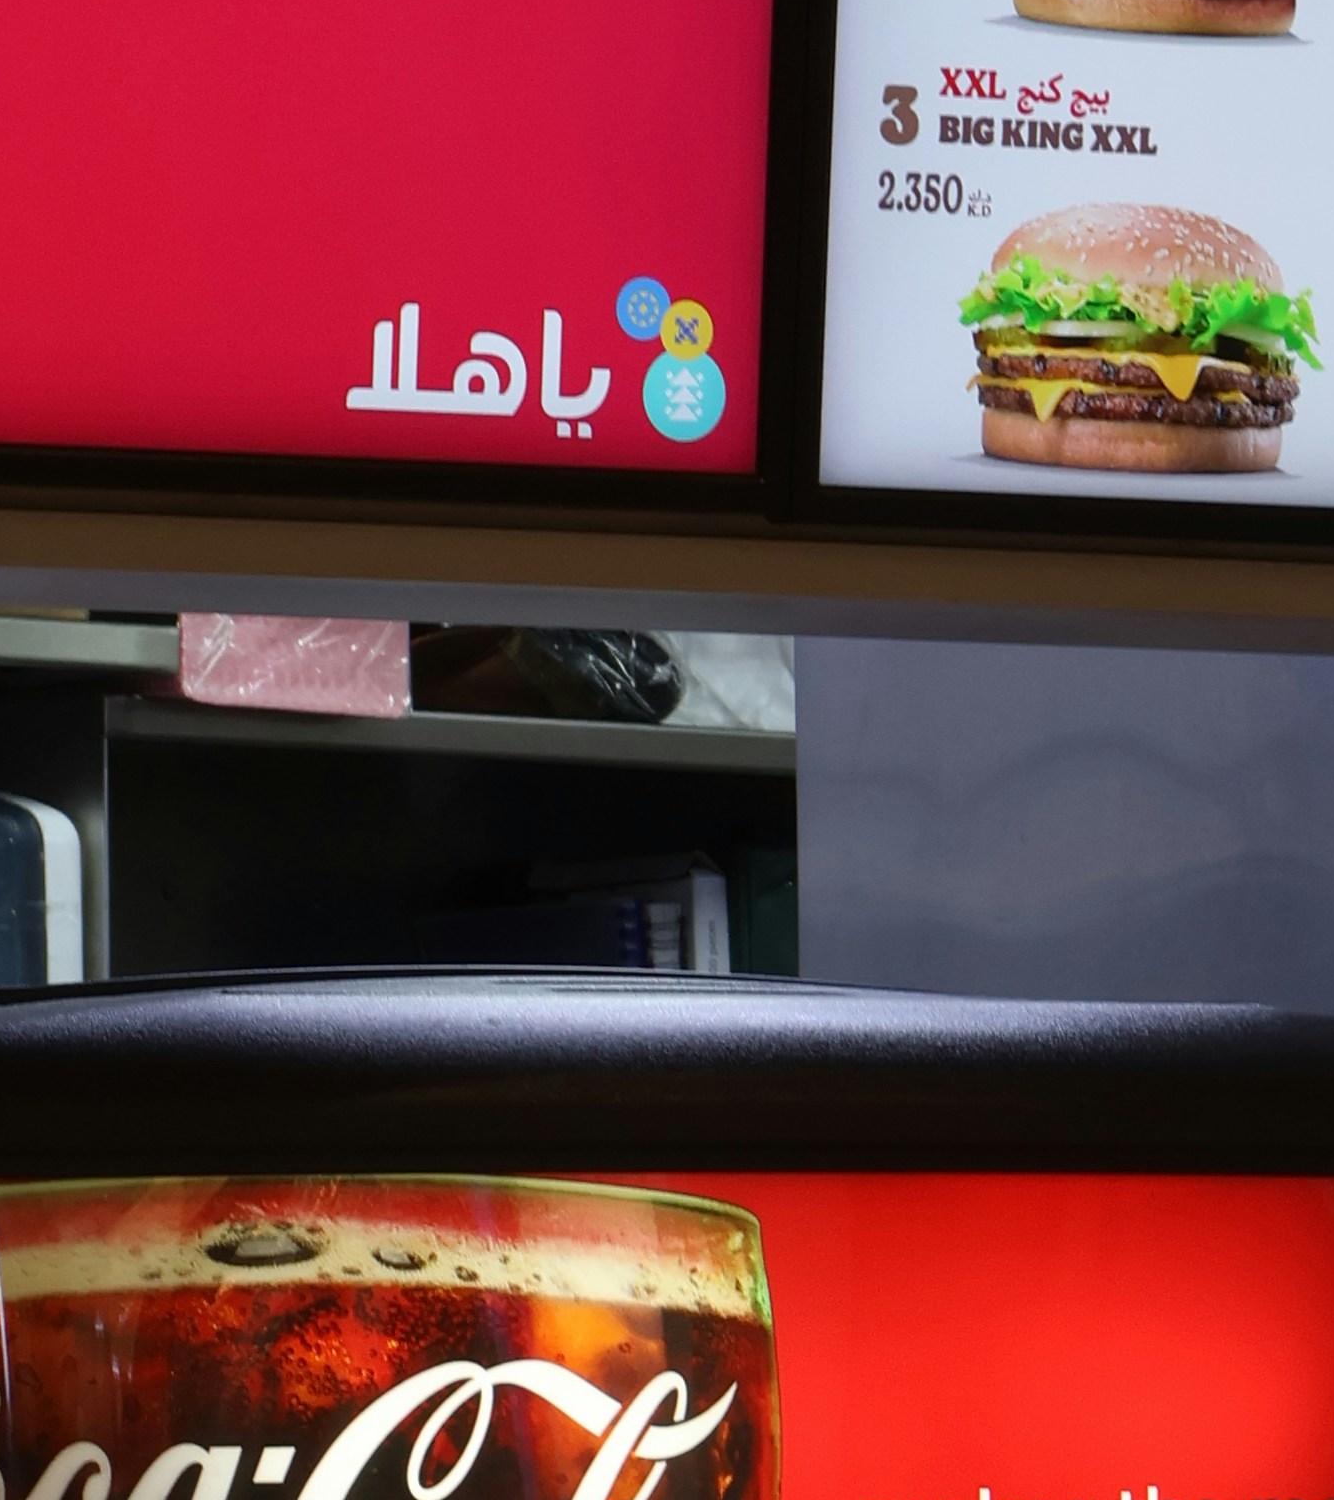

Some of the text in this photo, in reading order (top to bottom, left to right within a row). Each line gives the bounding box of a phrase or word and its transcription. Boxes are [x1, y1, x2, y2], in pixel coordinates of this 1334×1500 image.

[879, 84, 921, 147] 3
[939, 66, 1111, 118] بيج كنج XXL
[938, 114, 1159, 156] BIG KING XXL
[877, 168, 964, 215] 2.350
